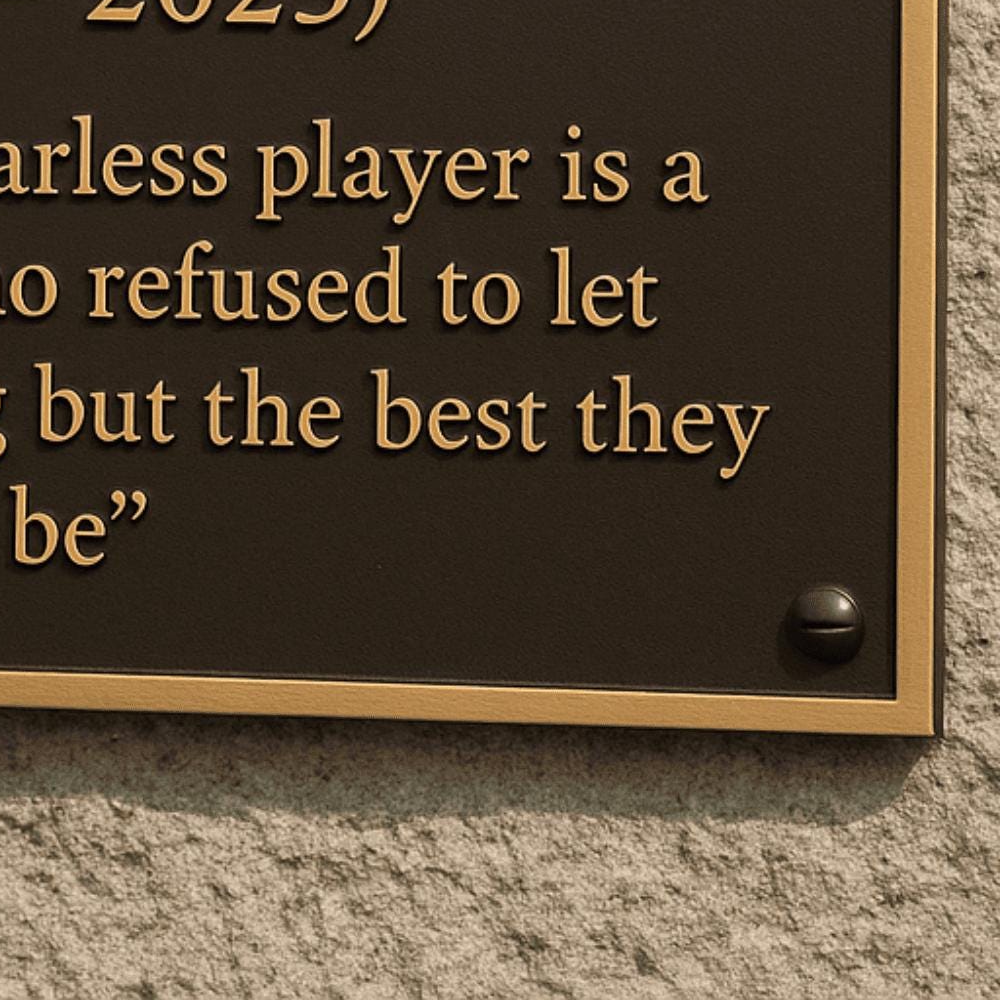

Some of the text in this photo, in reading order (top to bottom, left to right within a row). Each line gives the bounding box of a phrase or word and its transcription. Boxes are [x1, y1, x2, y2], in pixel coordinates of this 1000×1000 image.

[254, 118, 531, 225] player
[559, 124, 631, 203] is
[662, 150, 710, 204] a
[87, 239, 408, 325] refused
[435, 262, 522, 326] to
[550, 244, 660, 329] let
[33, 361, 178, 445] but
[202, 366, 342, 449] the
[372, 368, 548, 453] best
[575, 373, 772, 480] they
[8, 483, 148, 567] be”
